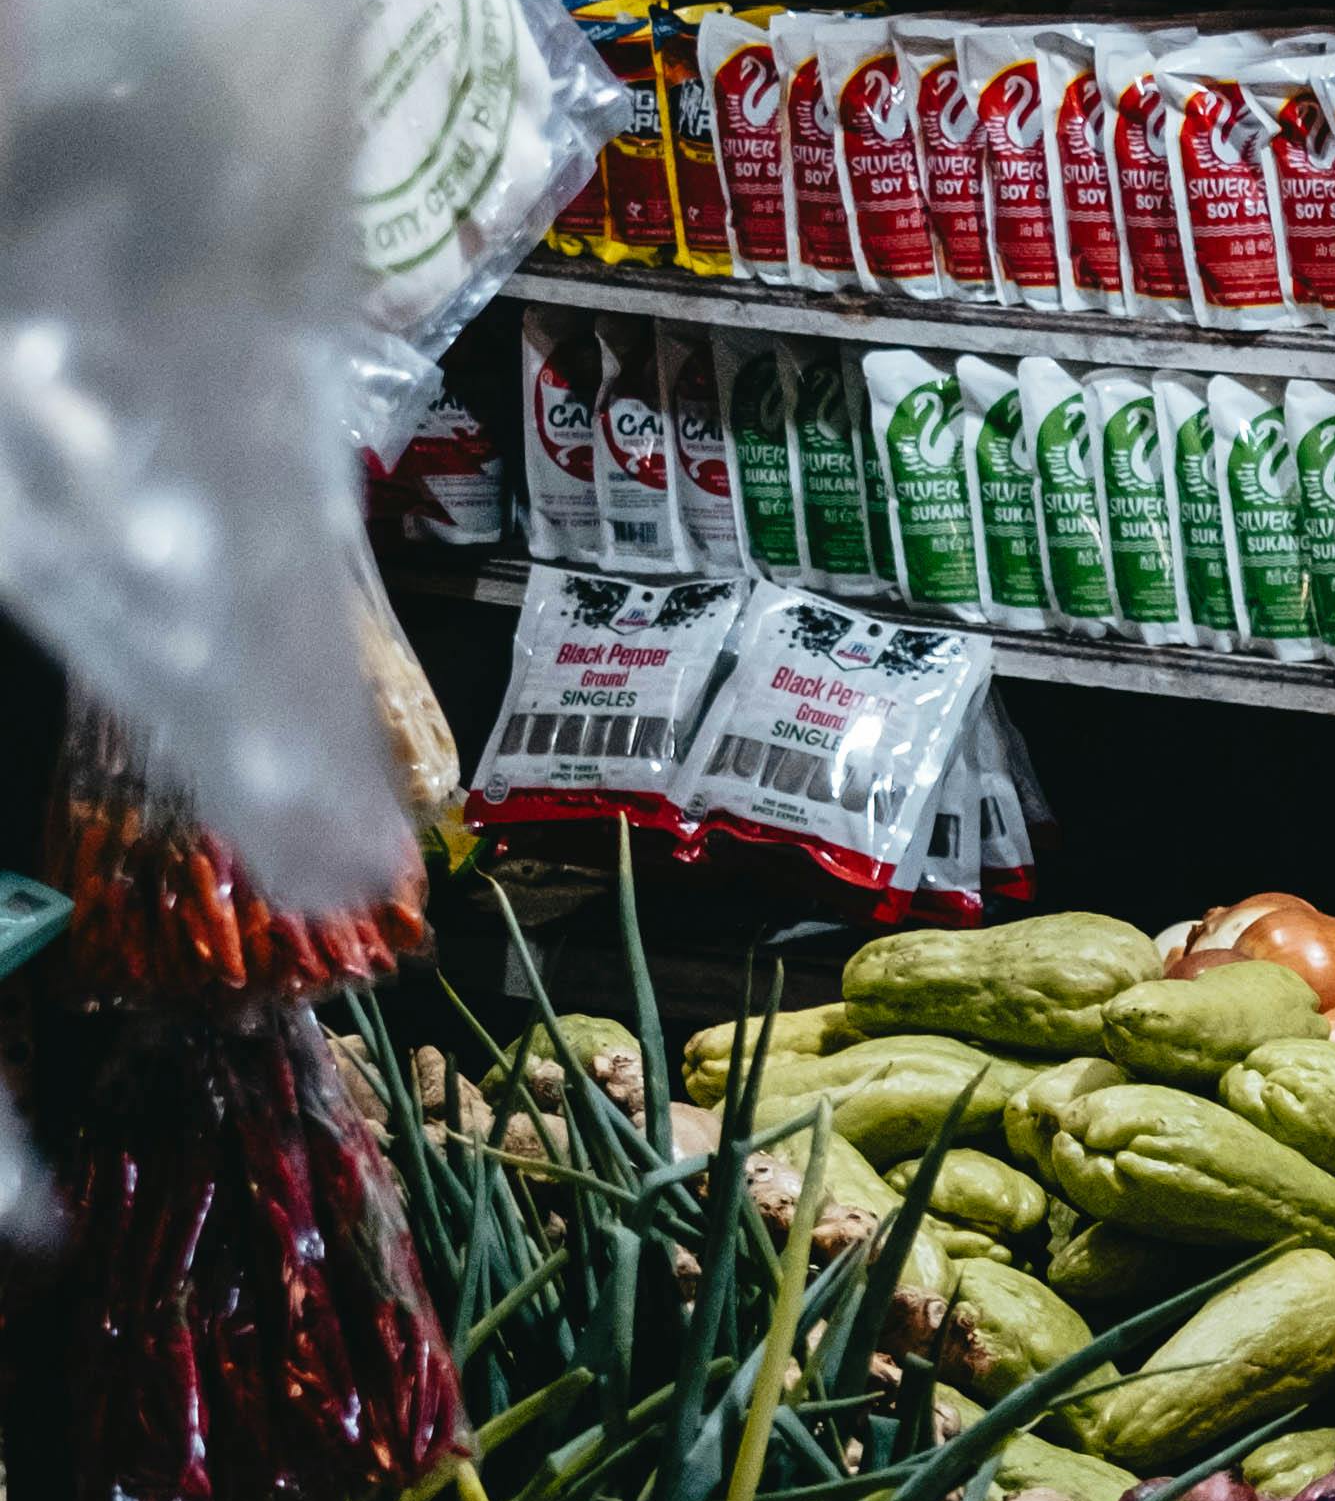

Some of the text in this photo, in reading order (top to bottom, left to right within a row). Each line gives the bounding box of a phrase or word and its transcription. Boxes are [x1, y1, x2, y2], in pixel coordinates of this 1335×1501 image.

[792, 145, 834, 166] SILVE
[851, 151, 917, 178] SILVER
[734, 161, 761, 178] SOY
[1064, 164, 1108, 186] SILVE
[870, 178, 904, 195] SOY
[935, 177, 965, 196] SOY
[999, 182, 1030, 201] SOY
[1189, 177, 1251, 200] SILVER
[1077, 188, 1107, 206] SOY
[1135, 193, 1163, 210] SOY
[1206, 201, 1240, 220] SOY
[1294, 201, 1324, 220] SOY
[744, 468, 788, 484] SUKAN
[897, 479, 961, 501] SILVER
[982, 480, 1032, 503] SILVE
[1044, 492, 1096, 515] SILVE
[994, 505, 1033, 523] SUKA
[1236, 510, 1298, 532] SILVER
[556, 643, 673, 669] Black Pepper
[580, 669, 630, 688] Ground
[770, 665, 829, 700] Black
[560, 689, 638, 708] SINGLES
[795, 702, 849, 732] Ground
